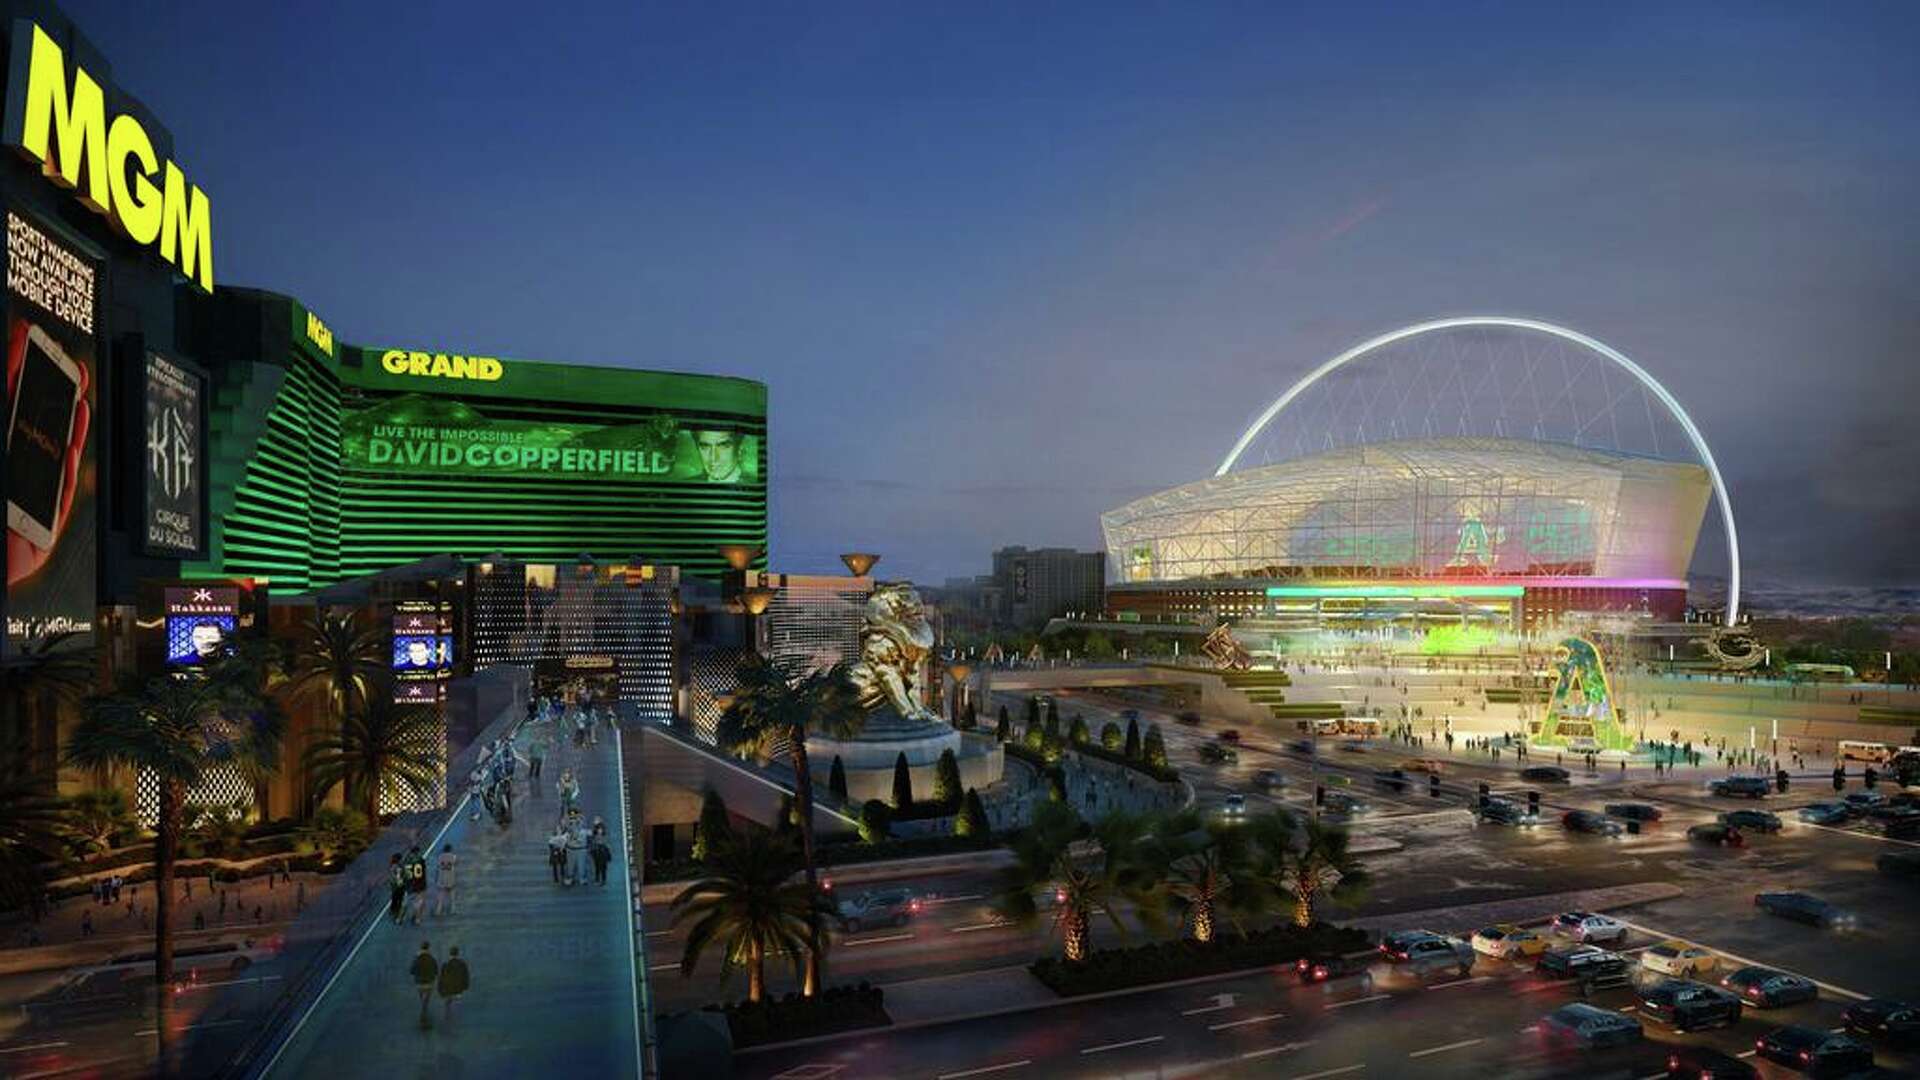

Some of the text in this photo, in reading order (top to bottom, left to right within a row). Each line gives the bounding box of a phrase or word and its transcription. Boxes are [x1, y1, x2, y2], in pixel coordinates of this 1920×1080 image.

[23, 24, 213, 294] MGM
[8, 212, 47, 252] SPORTS
[7, 230, 94, 300] NOW AVAILABLE
[8, 249, 93, 316] THROUGH YOUR
[7, 268, 93, 334] MOBILE DEVICE
[307, 311, 333, 358] MGM
[382, 350, 503, 380] GRAND
[373, 425, 524, 443] LIVE THE IMPOSSIBLE
